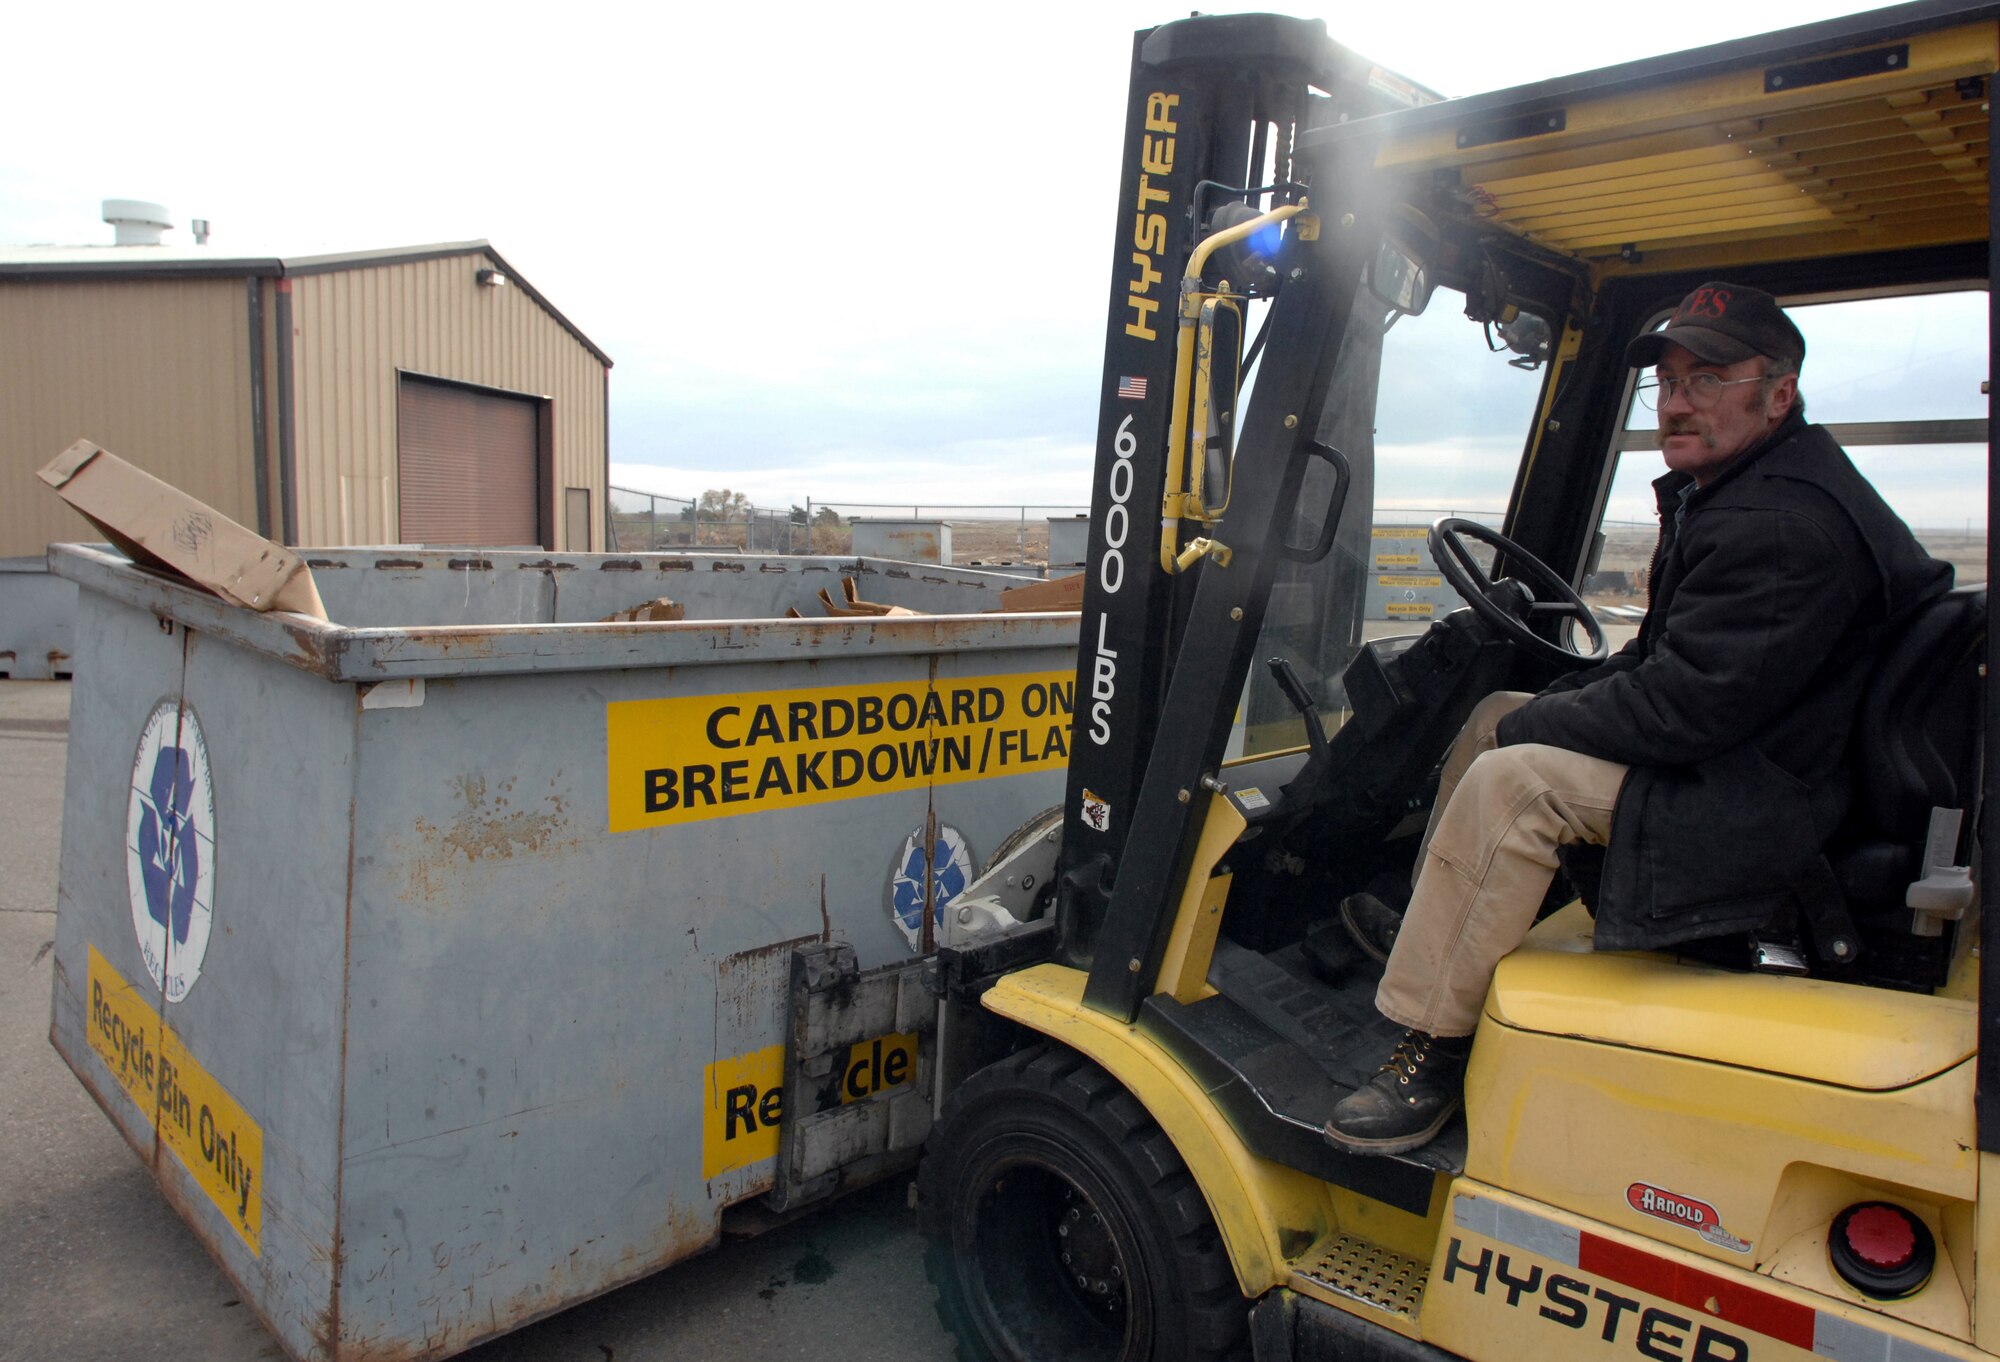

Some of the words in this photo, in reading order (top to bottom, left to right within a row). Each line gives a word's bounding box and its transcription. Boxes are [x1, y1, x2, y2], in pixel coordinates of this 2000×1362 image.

[1125, 91, 1180, 341] HYSTER
[1674, 288, 1733, 320] ES
[1100, 413, 1137, 593] 6000
[705, 686, 1005, 749] CARDBOARD
[1021, 681, 1073, 718] ON
[1089, 612, 1117, 745] LBS
[93, 976, 155, 1092] Recycle
[159, 1055, 192, 1139] Bin
[200, 1103, 253, 1217] Only
[725, 1040, 909, 1141] Recle
